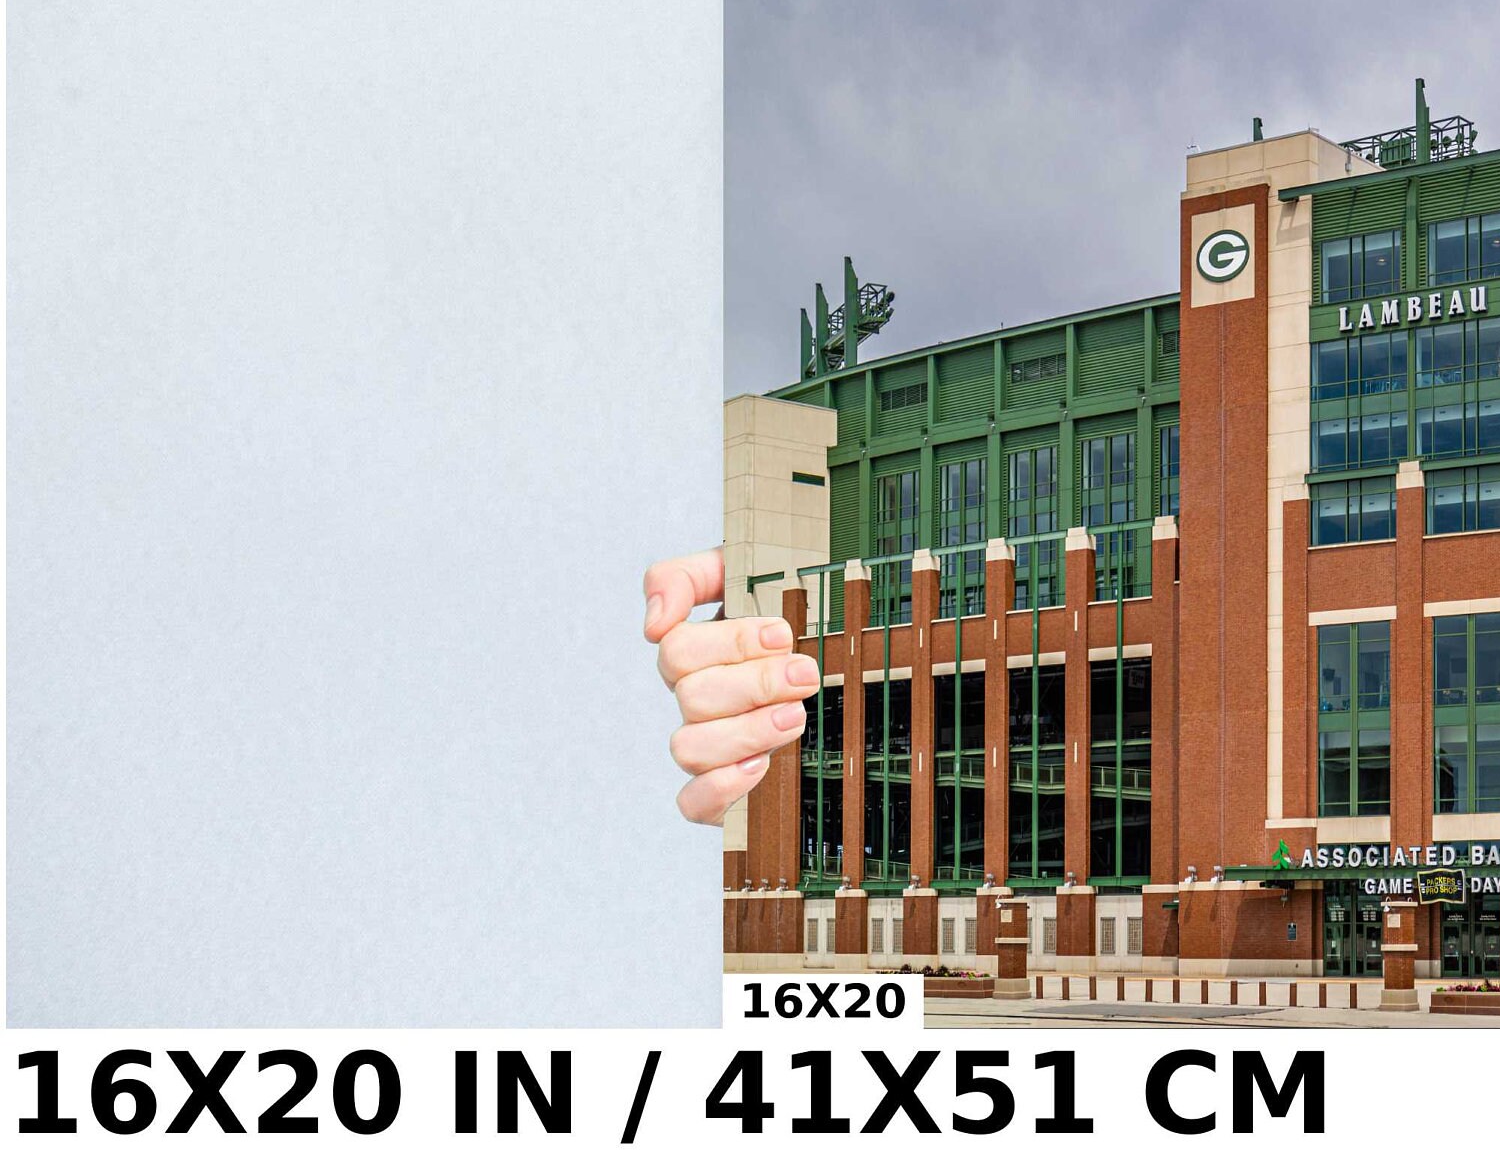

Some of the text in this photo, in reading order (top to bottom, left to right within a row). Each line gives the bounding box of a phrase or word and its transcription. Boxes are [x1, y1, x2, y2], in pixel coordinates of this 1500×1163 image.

[1198, 232, 1248, 281] G
[1339, 286, 1487, 331] LAMBEAU
[1301, 846, 1456, 868] ASSOCIATED
[1364, 878, 1413, 894] GAME
[1426, 876, 1455, 886] PACKERS
